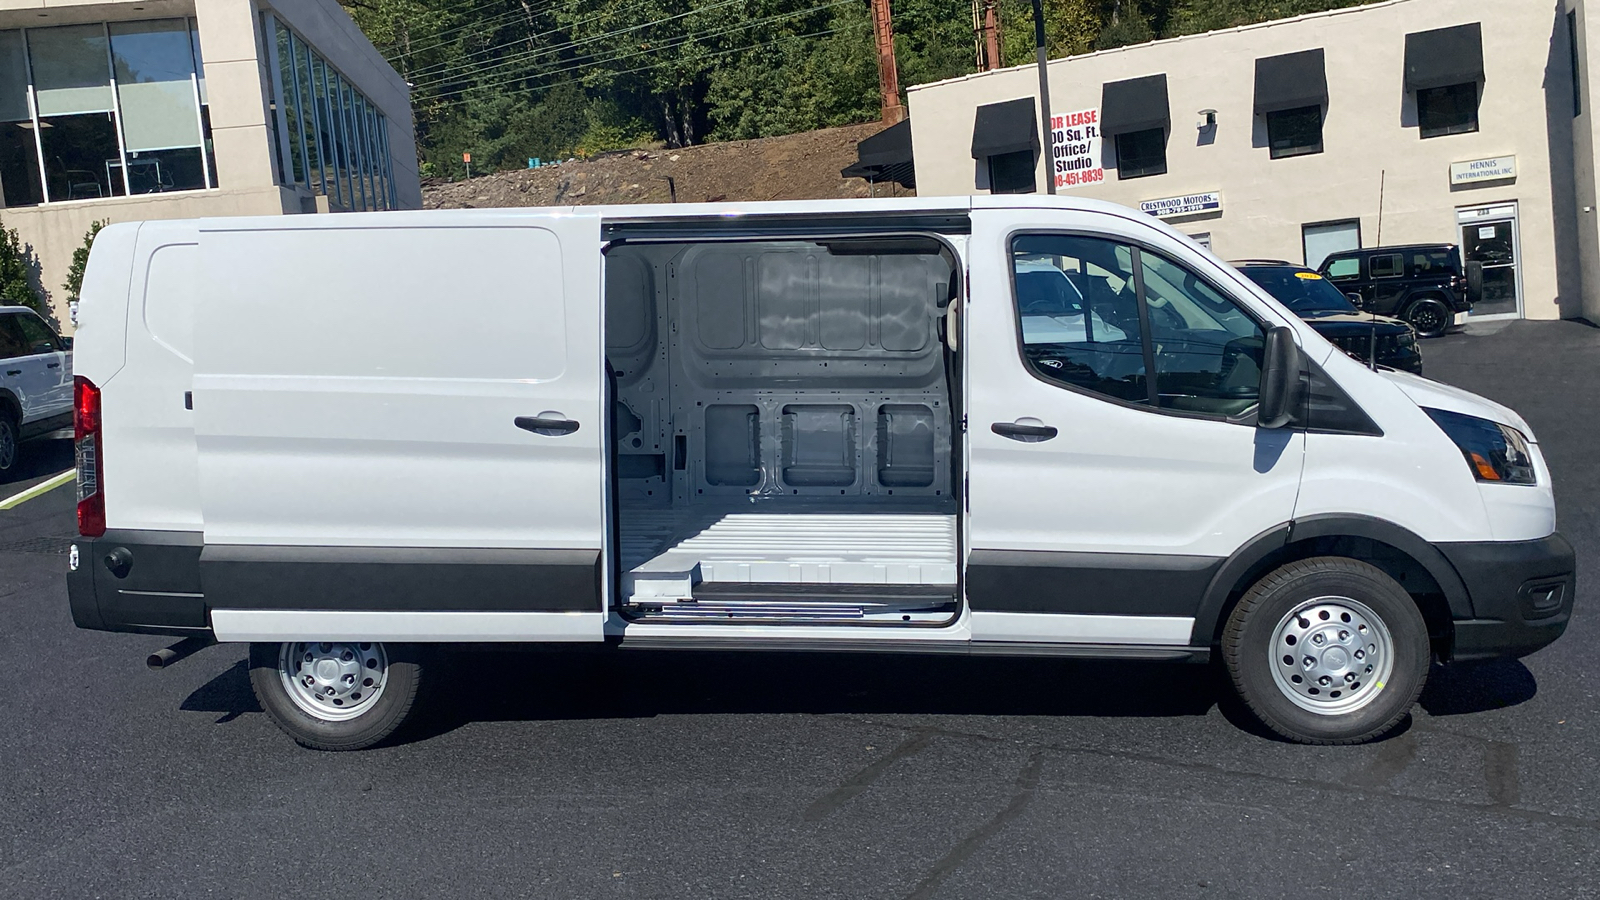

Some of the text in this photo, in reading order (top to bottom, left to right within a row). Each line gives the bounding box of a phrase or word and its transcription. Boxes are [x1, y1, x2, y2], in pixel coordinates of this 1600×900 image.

[1051, 110, 1097, 130] OR LEASE
[1052, 126, 1099, 144] 00 Sq. Ft.
[1054, 141, 1091, 158] Office/
[1056, 157, 1092, 172] Studio
[1470, 160, 1497, 170] HENNIS
[1054, 168, 1103, 187] 08-451-8839
[1456, 169, 1501, 180] INTERNATIONAL
[1141, 194, 1211, 211] CRESTWOOD MOTORS
